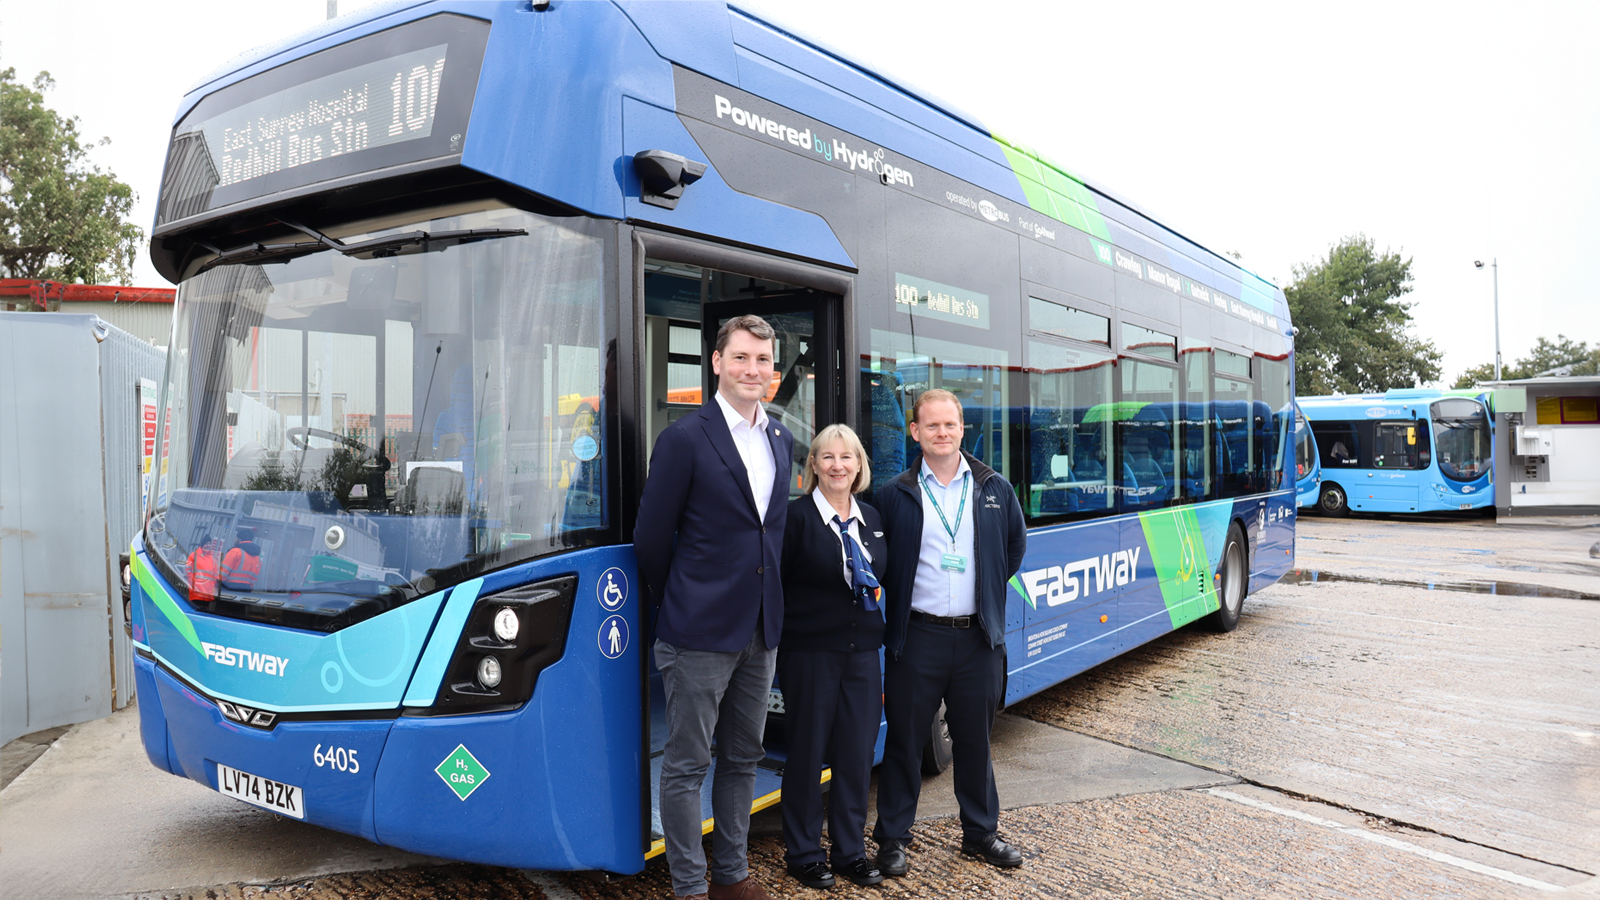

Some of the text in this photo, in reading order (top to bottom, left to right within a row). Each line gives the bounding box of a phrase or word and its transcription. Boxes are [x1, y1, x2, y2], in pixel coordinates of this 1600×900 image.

[224, 121, 253, 152] East
[331, 118, 368, 156] Stn
[714, 94, 914, 187] Powered by Hydrogen
[945, 191, 978, 212] operated by
[979, 200, 1010, 222] METROBUS
[1018, 217, 1029, 230] Part
[1098, 244, 1111, 262] 100
[1115, 251, 1143, 279] Crawley
[1147, 265, 1181, 293] Manor Royal
[895, 283, 918, 307] 100
[1365, 407, 1401, 418] METROBUS
[313, 743, 360, 774] 6405
[223, 767, 297, 812] LV74 BZK
[450, 773, 475, 785] GAS
